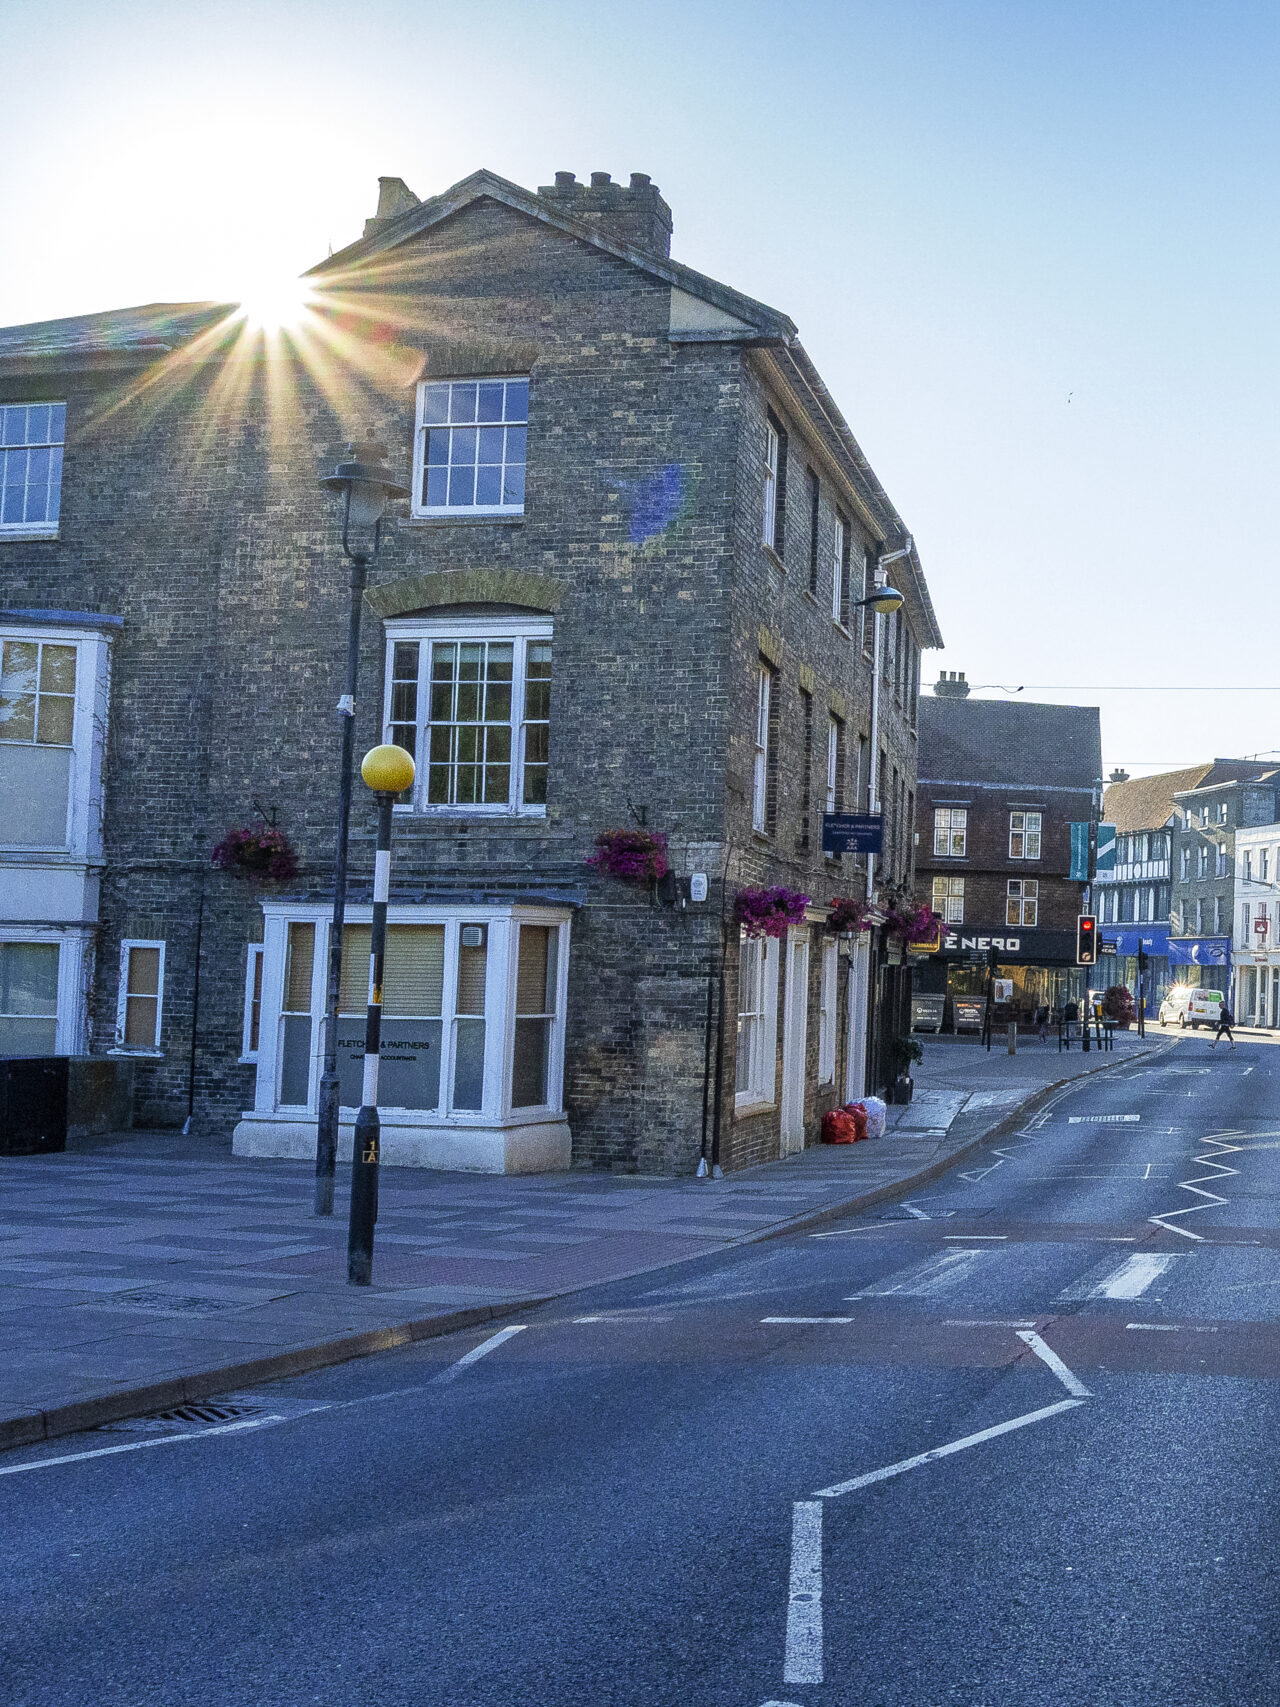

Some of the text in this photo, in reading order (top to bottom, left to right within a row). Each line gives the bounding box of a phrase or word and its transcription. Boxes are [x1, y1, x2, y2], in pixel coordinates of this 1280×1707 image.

[961, 937, 1020, 951] NERO
[381, 1041, 386, 1049] &
[388, 1041, 430, 1050] PARTNERS
[370, 1140, 376, 1150] 1
[367, 1151, 376, 1162] A
